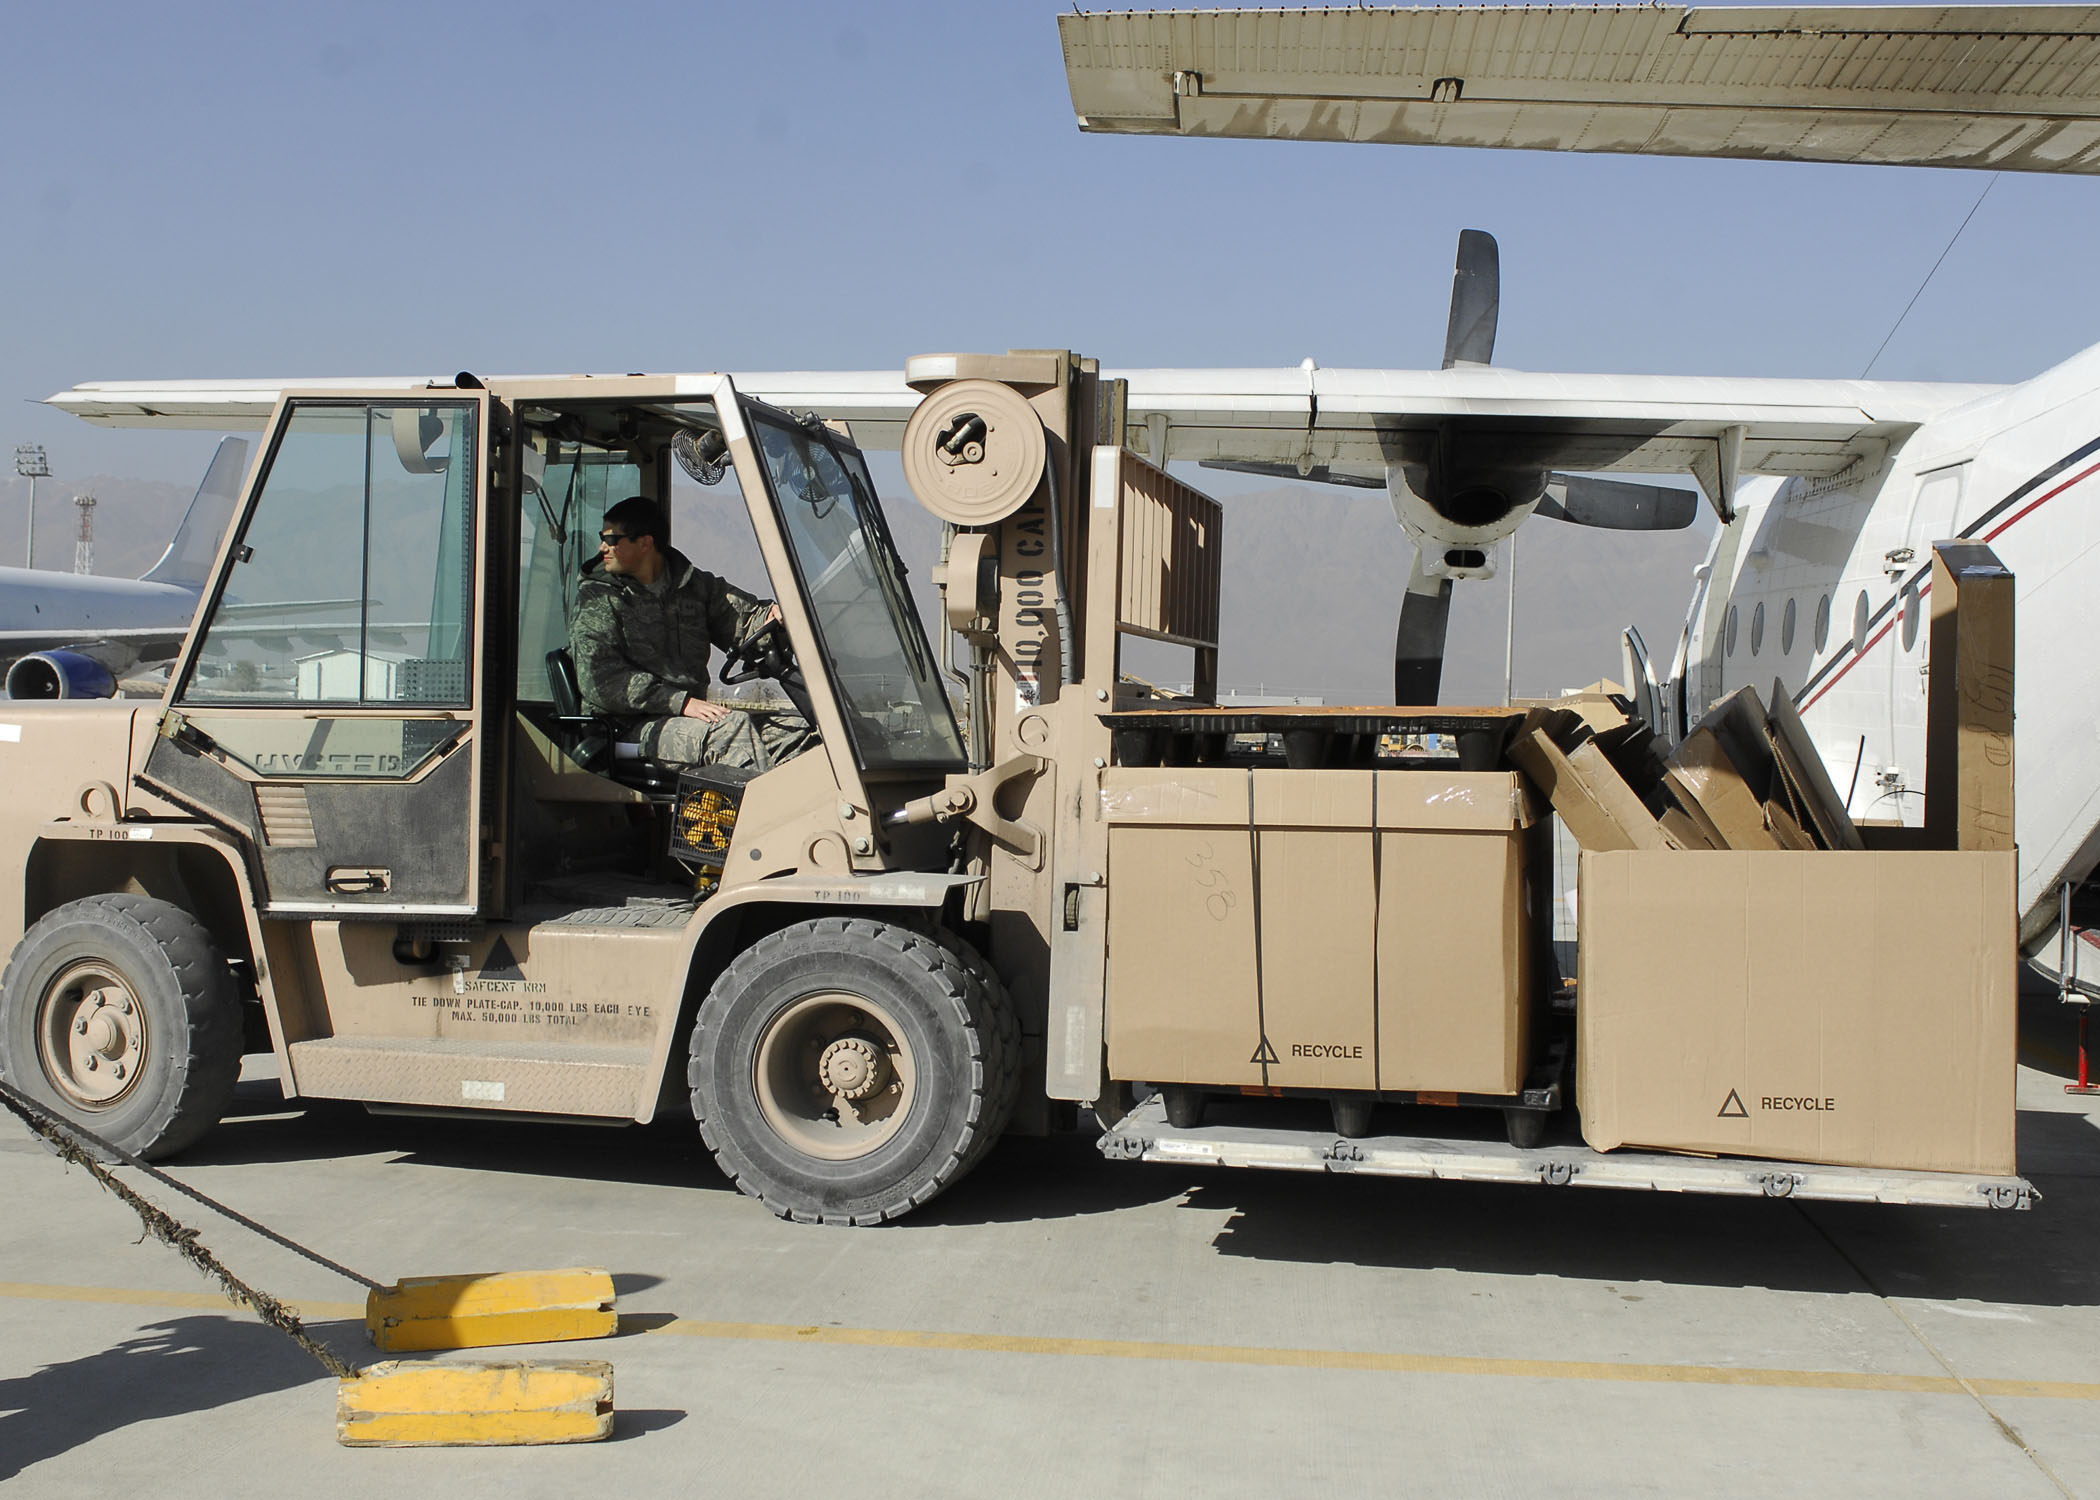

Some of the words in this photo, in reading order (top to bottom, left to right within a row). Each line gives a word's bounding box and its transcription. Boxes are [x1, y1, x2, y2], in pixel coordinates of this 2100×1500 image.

[1015, 570, 1045, 667] 10,000
[90, 829, 103, 839] TP
[109, 830, 128, 840] 100
[814, 890, 830, 901] TP
[838, 891, 861, 901] 100
[412, 997, 427, 1007] TIE
[433, 998, 461, 1008] DOWN
[530, 1001, 564, 1012] 10,000
[570, 1003, 588, 1013] LBS
[594, 1004, 619, 1014] EACH
[628, 1006, 650, 1017] EYE
[452, 1011, 477, 1021] MAX.
[482, 1012, 517, 1023] 50,000
[523, 1014, 541, 1024] LBS
[547, 1015, 577, 1025] TOTAL
[1292, 1044, 1362, 1059] RECYCLE
[1762, 1097, 1835, 1111] RECYCLE
